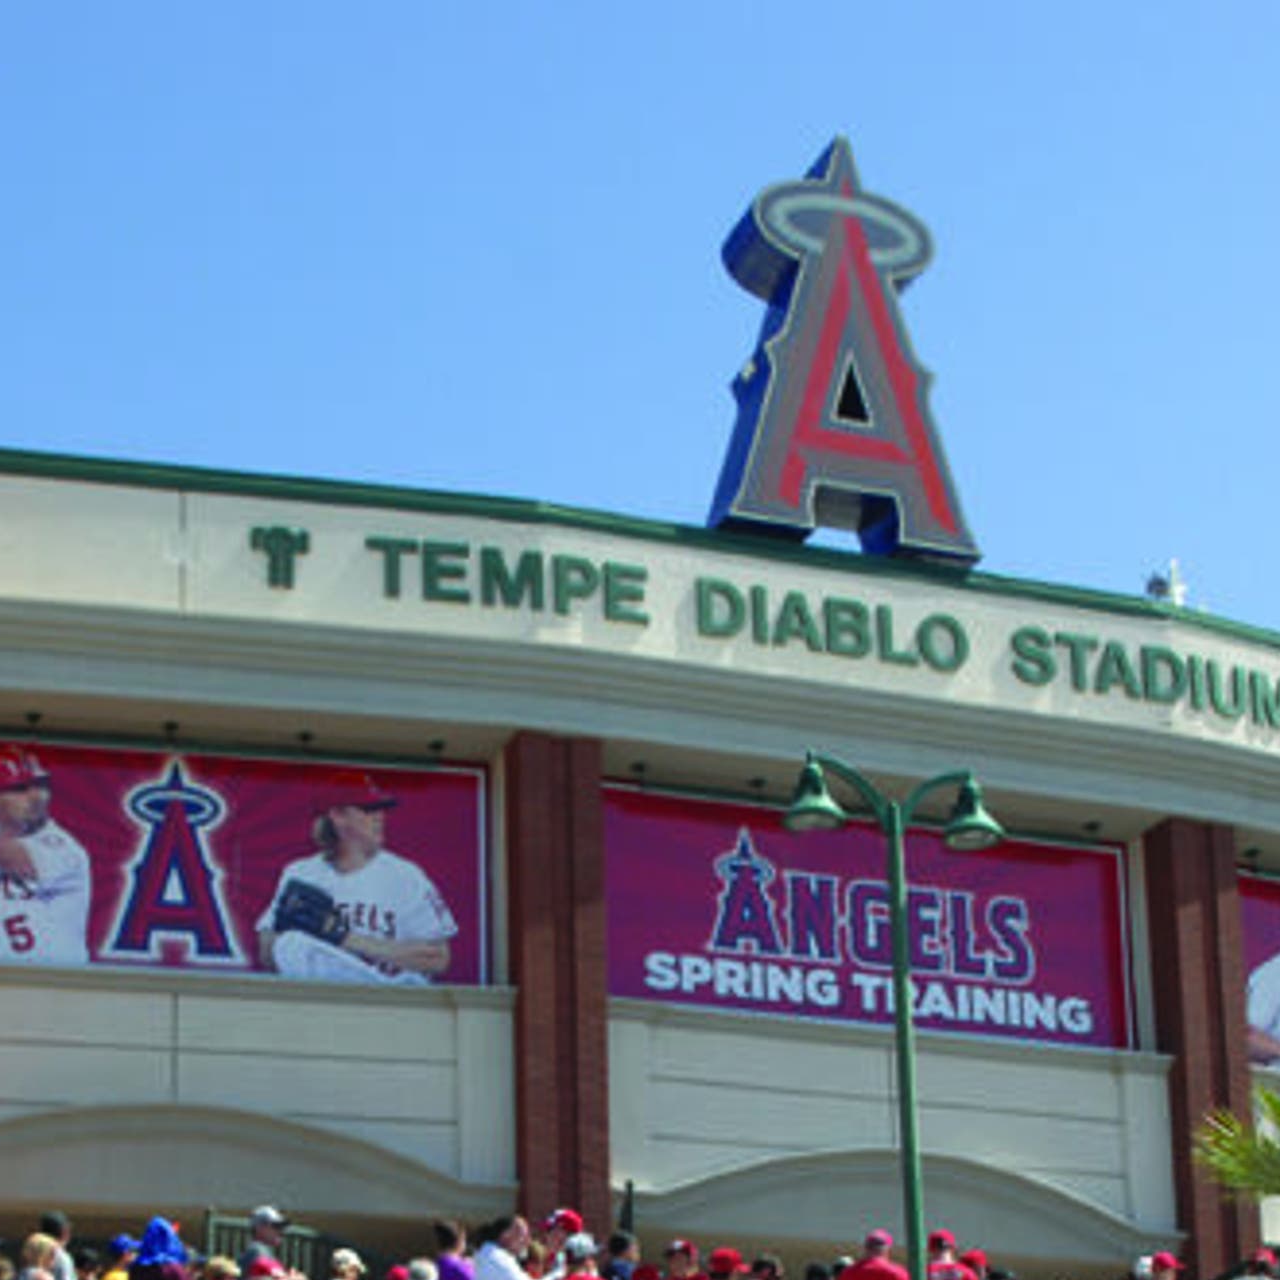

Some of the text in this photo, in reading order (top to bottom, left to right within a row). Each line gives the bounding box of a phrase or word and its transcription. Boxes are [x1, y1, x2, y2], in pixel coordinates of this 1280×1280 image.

[723, 134, 983, 558] A
[364, 534, 651, 628] TEMPE
[693, 575, 971, 673] DIABLO
[4, 914, 36, 954] 5
[101, 755, 249, 967] A
[708, 826, 1037, 986] ANGELS
[643, 950, 1094, 1035] SPRING TAINING
